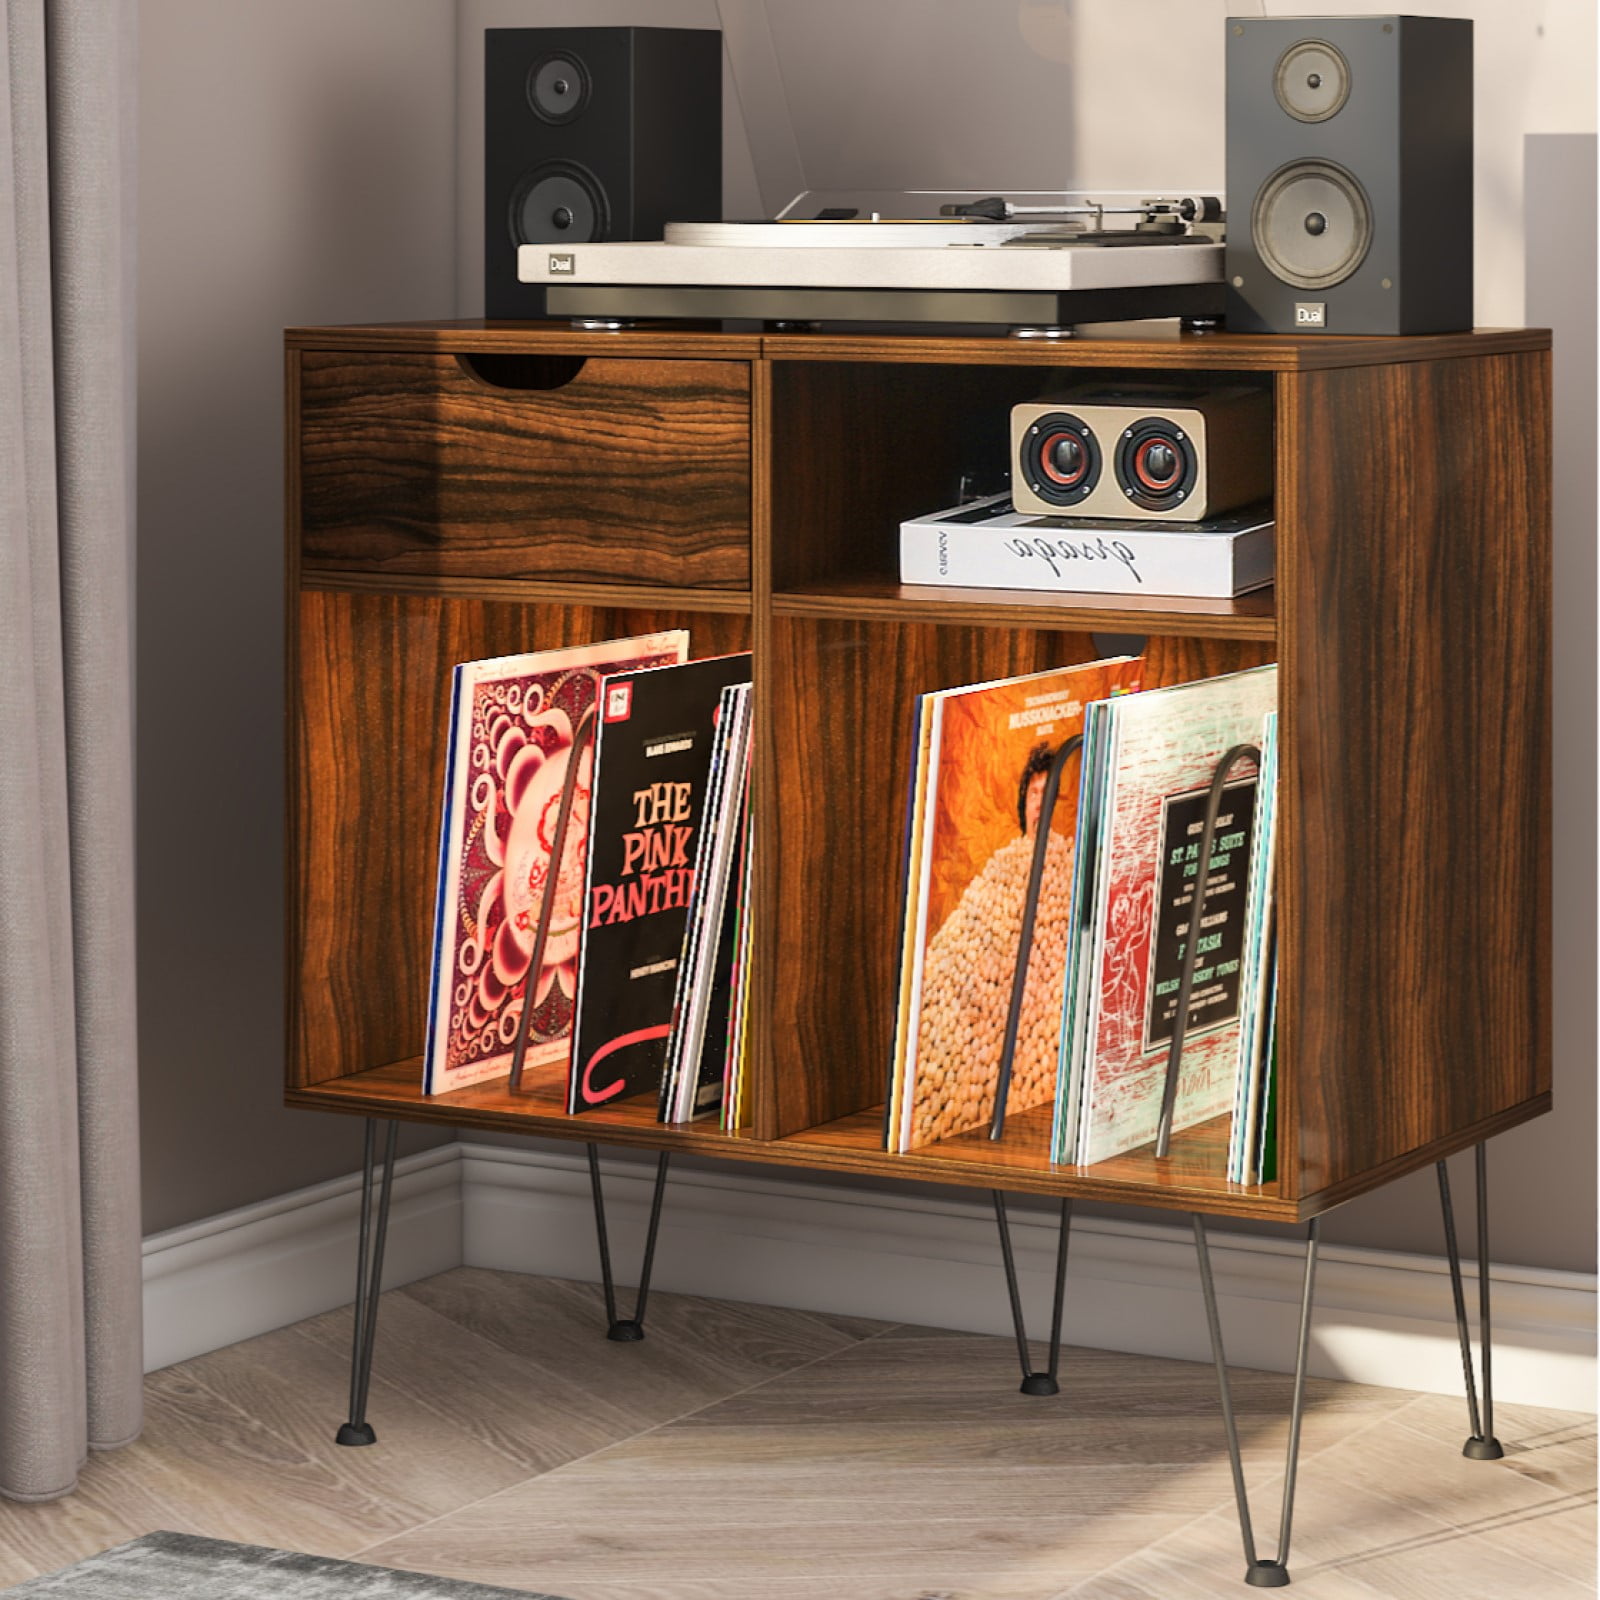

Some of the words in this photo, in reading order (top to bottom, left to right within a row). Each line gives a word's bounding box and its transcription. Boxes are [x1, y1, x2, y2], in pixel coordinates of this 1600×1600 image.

[550, 256, 572, 271] Dual
[1297, 306, 1323, 322] Dual
[633, 781, 692, 828] THE
[620, 823, 694, 877] PINK
[590, 868, 696, 929] PANTH
